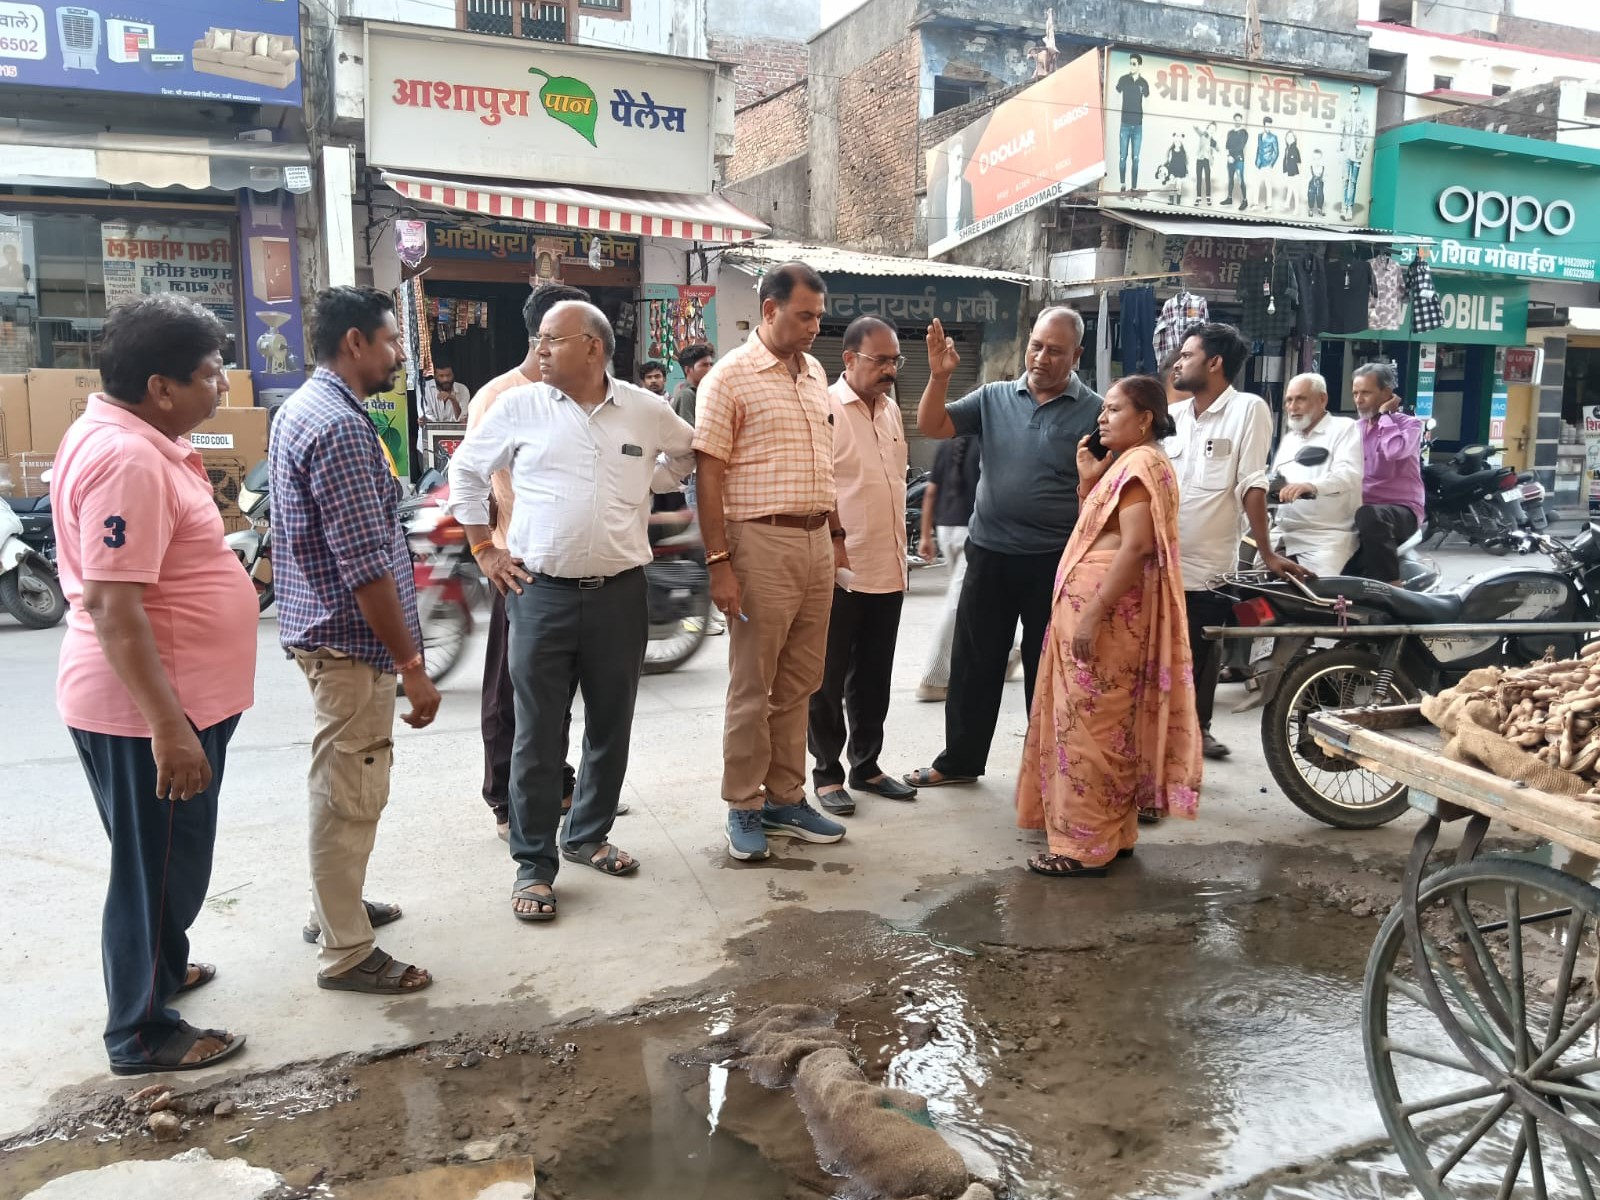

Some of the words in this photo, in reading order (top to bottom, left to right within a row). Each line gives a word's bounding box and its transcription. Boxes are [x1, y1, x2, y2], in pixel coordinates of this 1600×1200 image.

[0, 37, 38, 53] 6502
[1154, 63, 1193, 102] श्री
[1195, 66, 1254, 111] भैरव
[392, 77, 530, 126] आशापुरा
[544, 92, 593, 116] पान
[609, 89, 687, 133] पैलेस
[989, 128, 1036, 167] DOLLAR
[959, 222, 981, 241] SHREE
[981, 210, 1013, 230] BHAIRAV
[1014, 181, 1063, 214] READYMADE
[1400, 248, 1440, 263] SHV
[1440, 239, 1482, 265] शिव
[1485, 244, 1557, 274] मोबाईल
[957, 290, 999, 321] रानी
[1441, 293, 1505, 331] OBILE
[211, 436, 230, 445] COOL
[103, 515, 127, 549] 3
